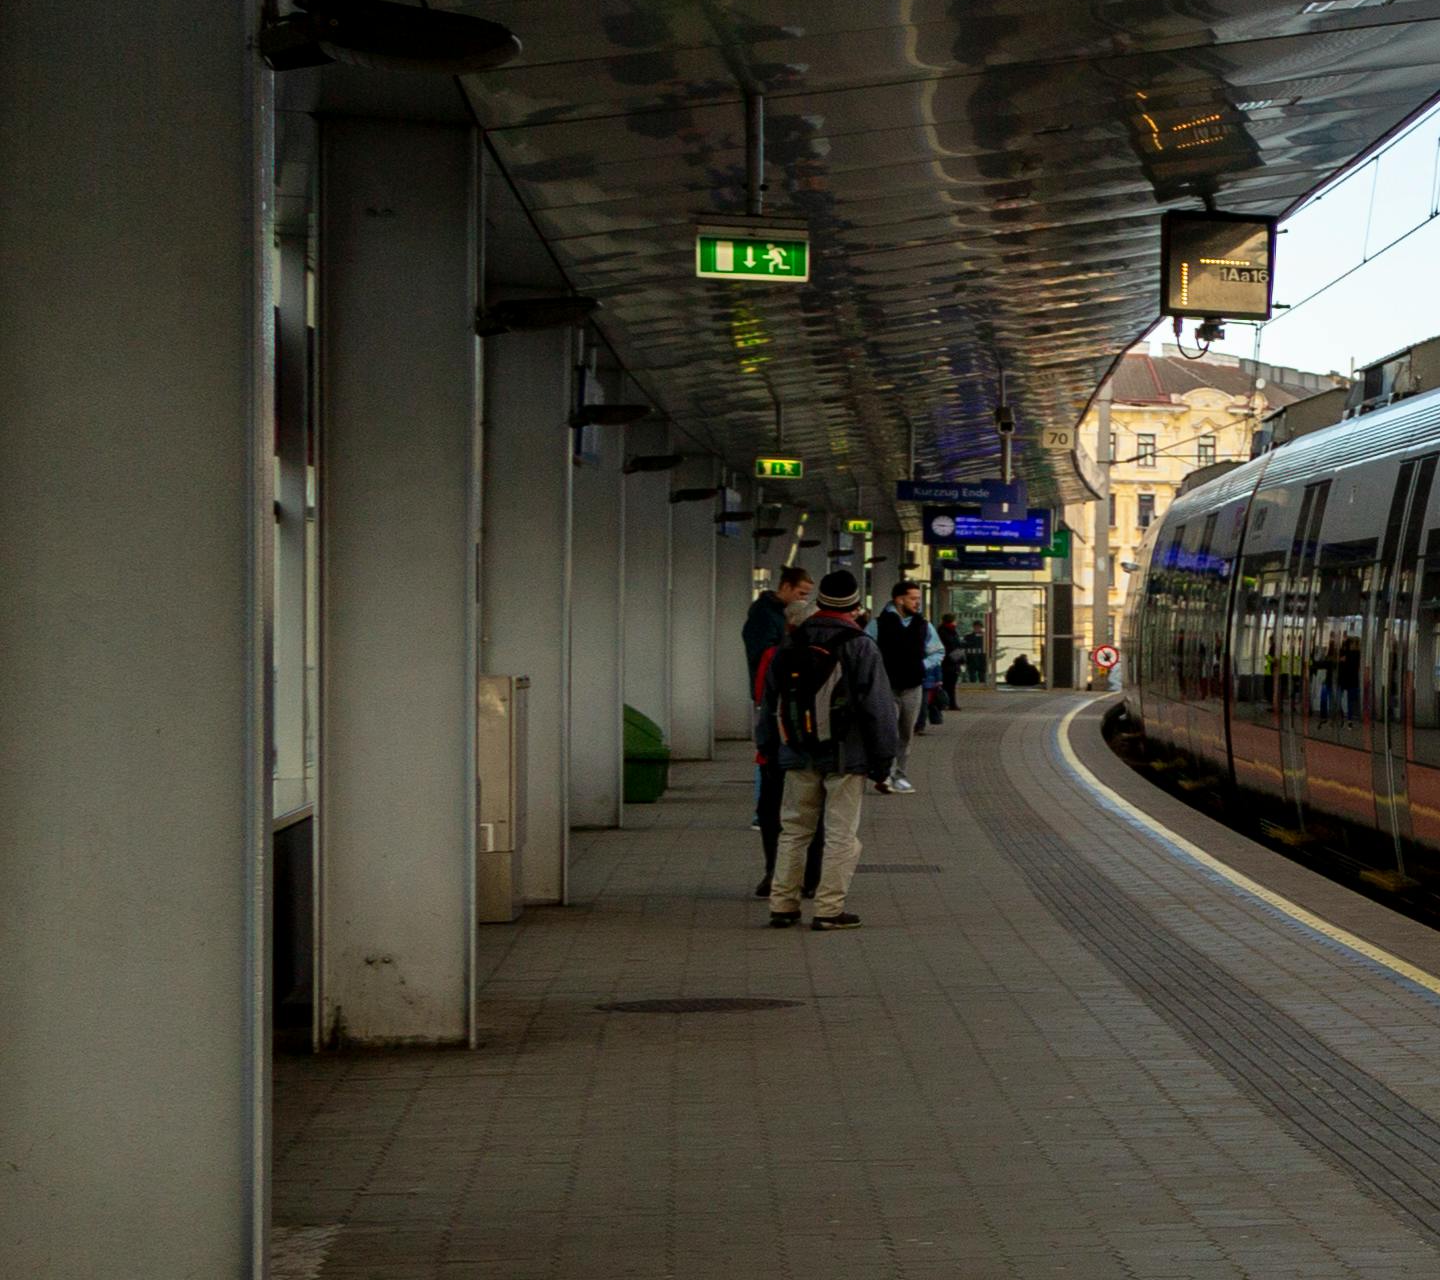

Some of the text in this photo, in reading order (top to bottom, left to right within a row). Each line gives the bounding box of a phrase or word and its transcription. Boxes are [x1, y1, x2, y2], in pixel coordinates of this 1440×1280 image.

[1221, 267, 1270, 283] 1Aa16
[1048, 431, 1069, 445] 70
[913, 487, 990, 499] Kurzzug Ende
